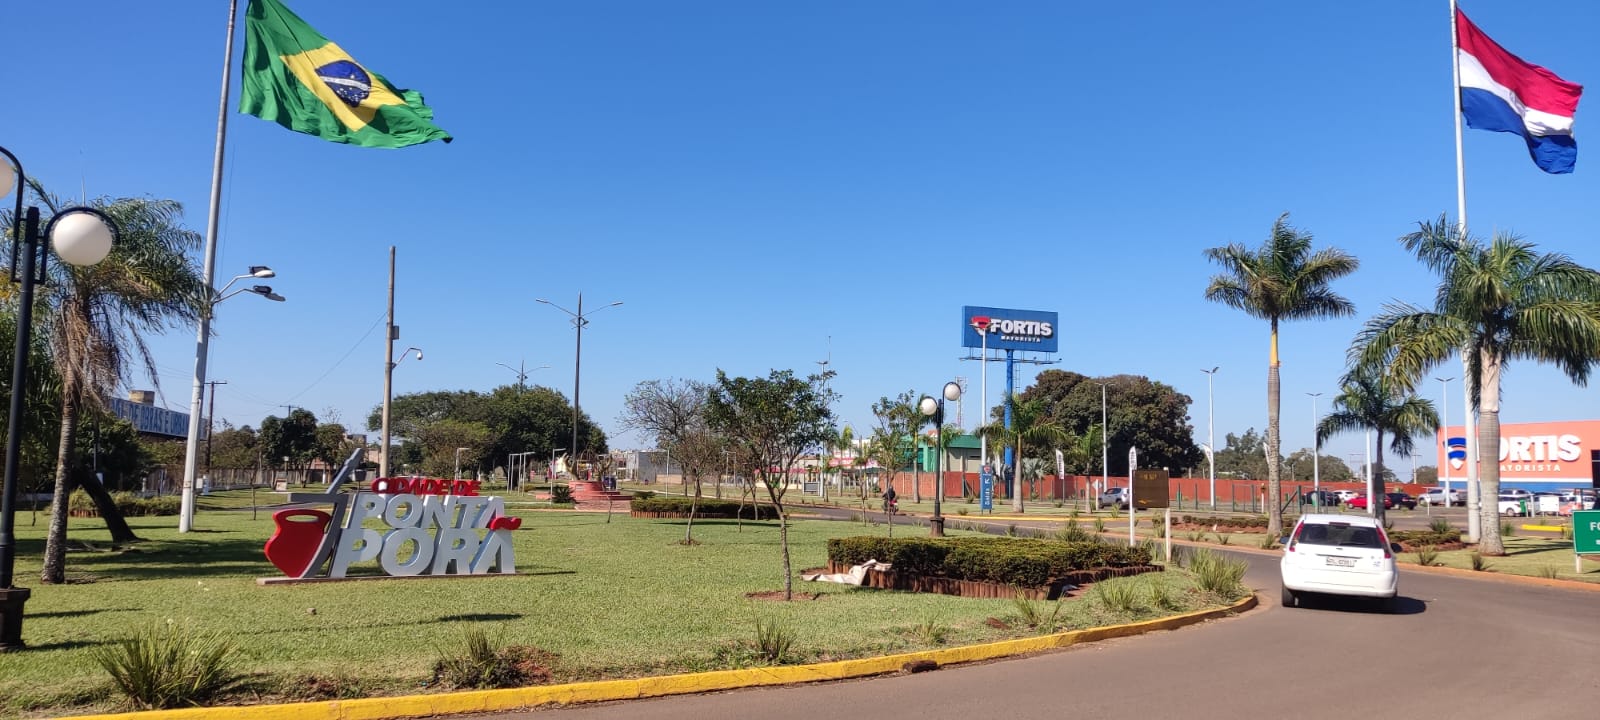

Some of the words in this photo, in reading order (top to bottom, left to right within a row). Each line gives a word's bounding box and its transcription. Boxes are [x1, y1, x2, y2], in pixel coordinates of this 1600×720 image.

[990, 318, 1052, 336] FORTIS
[1000, 335, 1041, 343] MAYORISTA
[1477, 434, 1582, 462] ORTIS
[1501, 464, 1562, 472] AYORISTA
[371, 477, 452, 496] CIDADE
[452, 479, 482, 496] DE
[345, 493, 505, 529] PONTA
[330, 517, 522, 578] PORÃ
